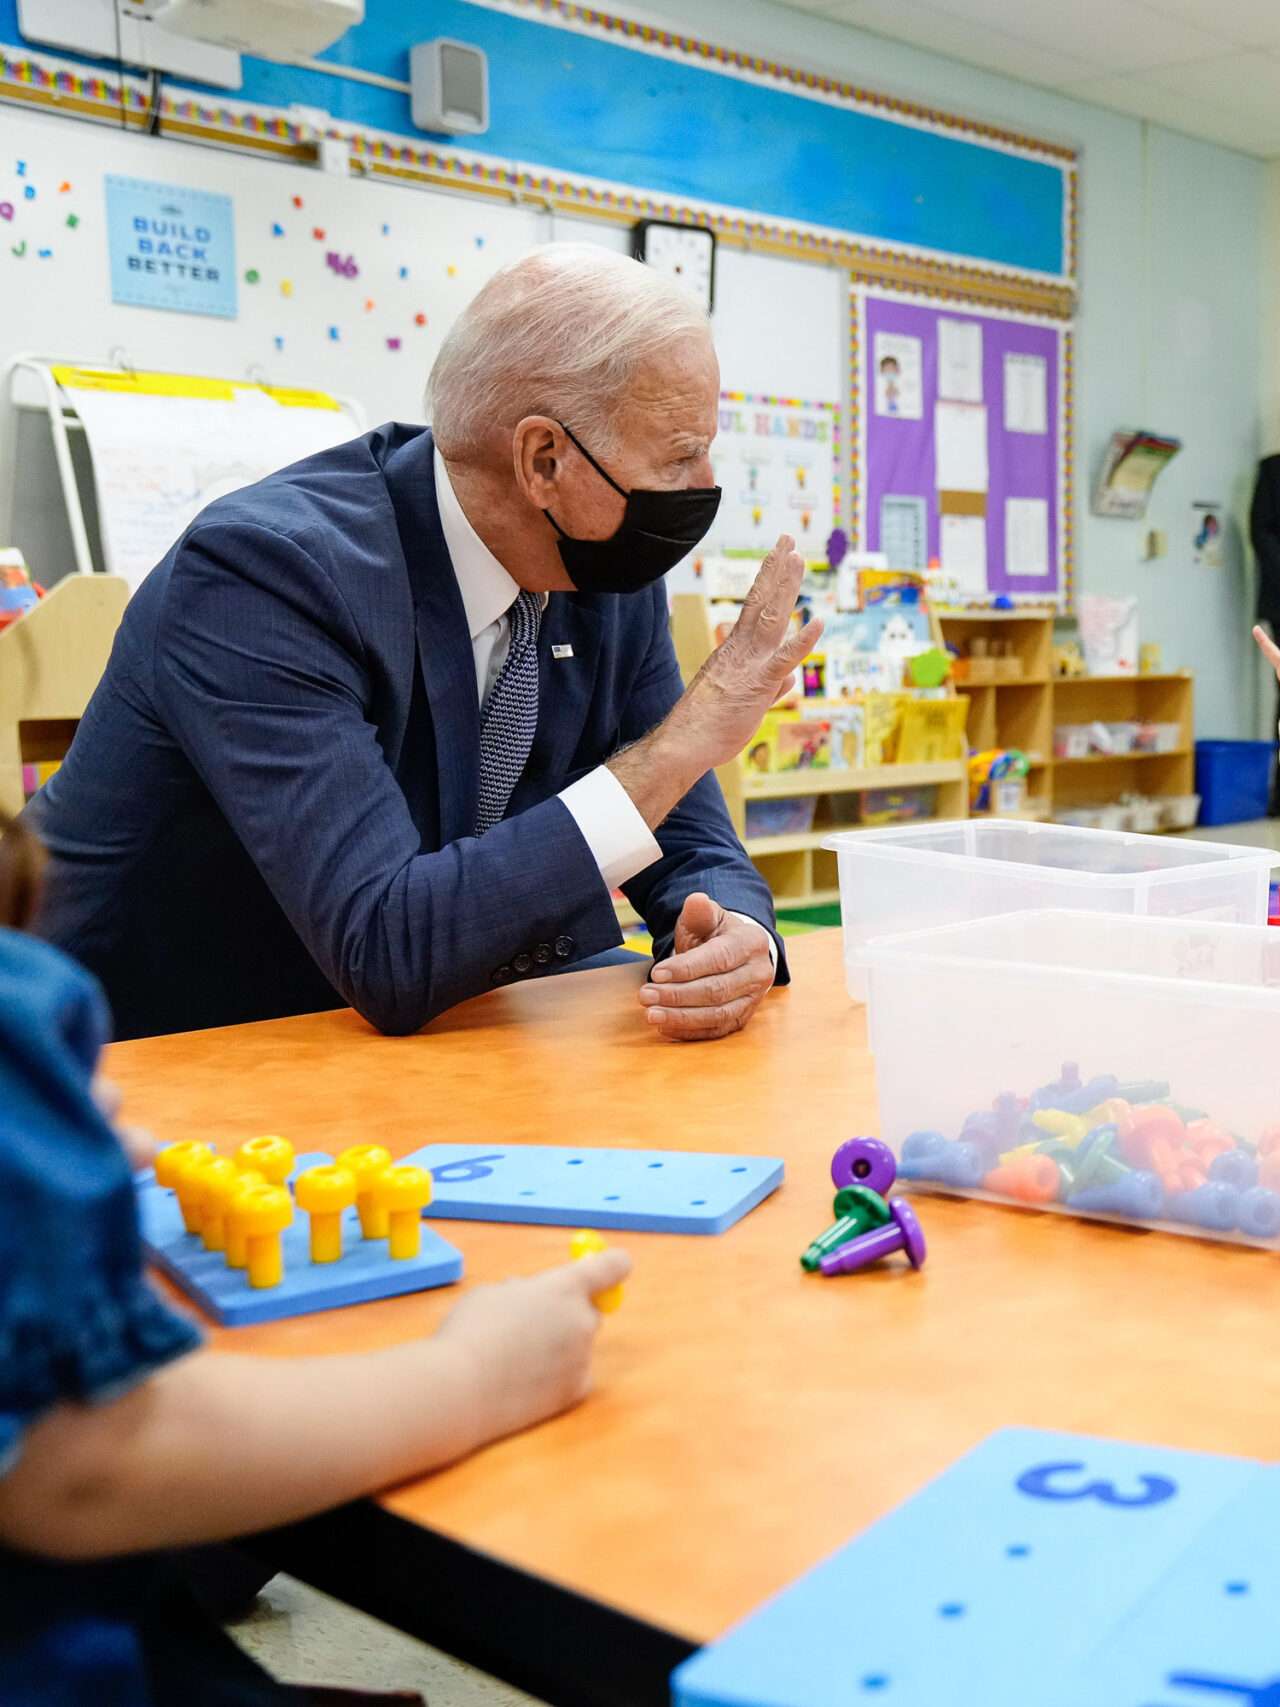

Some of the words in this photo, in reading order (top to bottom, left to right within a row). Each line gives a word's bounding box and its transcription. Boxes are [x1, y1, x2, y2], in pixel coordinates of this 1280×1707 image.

[132, 215, 212, 244] BUILD
[137, 236, 208, 263] BACK
[126, 256, 221, 283] BETTER
[754, 413, 829, 444] HANDS
[1016, 1460, 1178, 1508] 3
